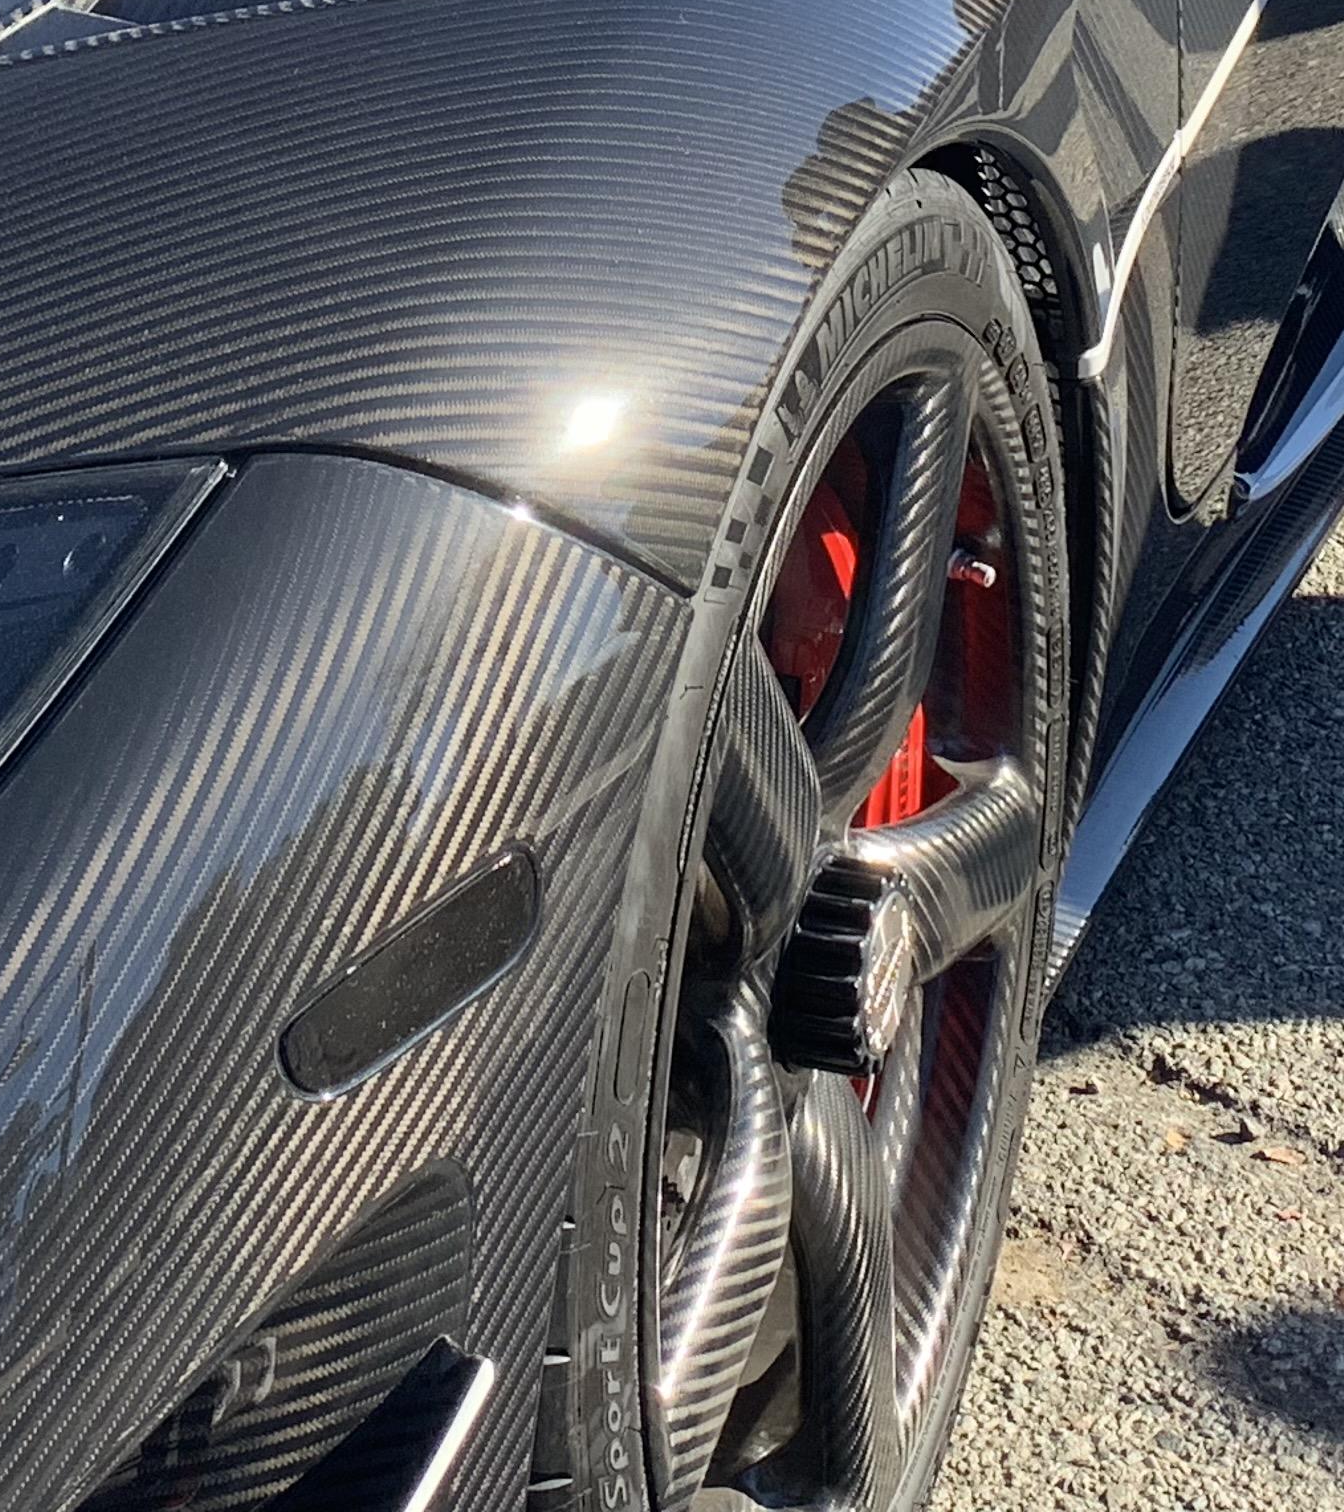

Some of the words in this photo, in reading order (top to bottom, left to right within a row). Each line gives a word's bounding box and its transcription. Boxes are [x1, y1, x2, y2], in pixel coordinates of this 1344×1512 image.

[816, 220, 944, 385] MICHELIN
[607, 1120, 629, 1173] 2
[600, 1193, 628, 1319] Cup
